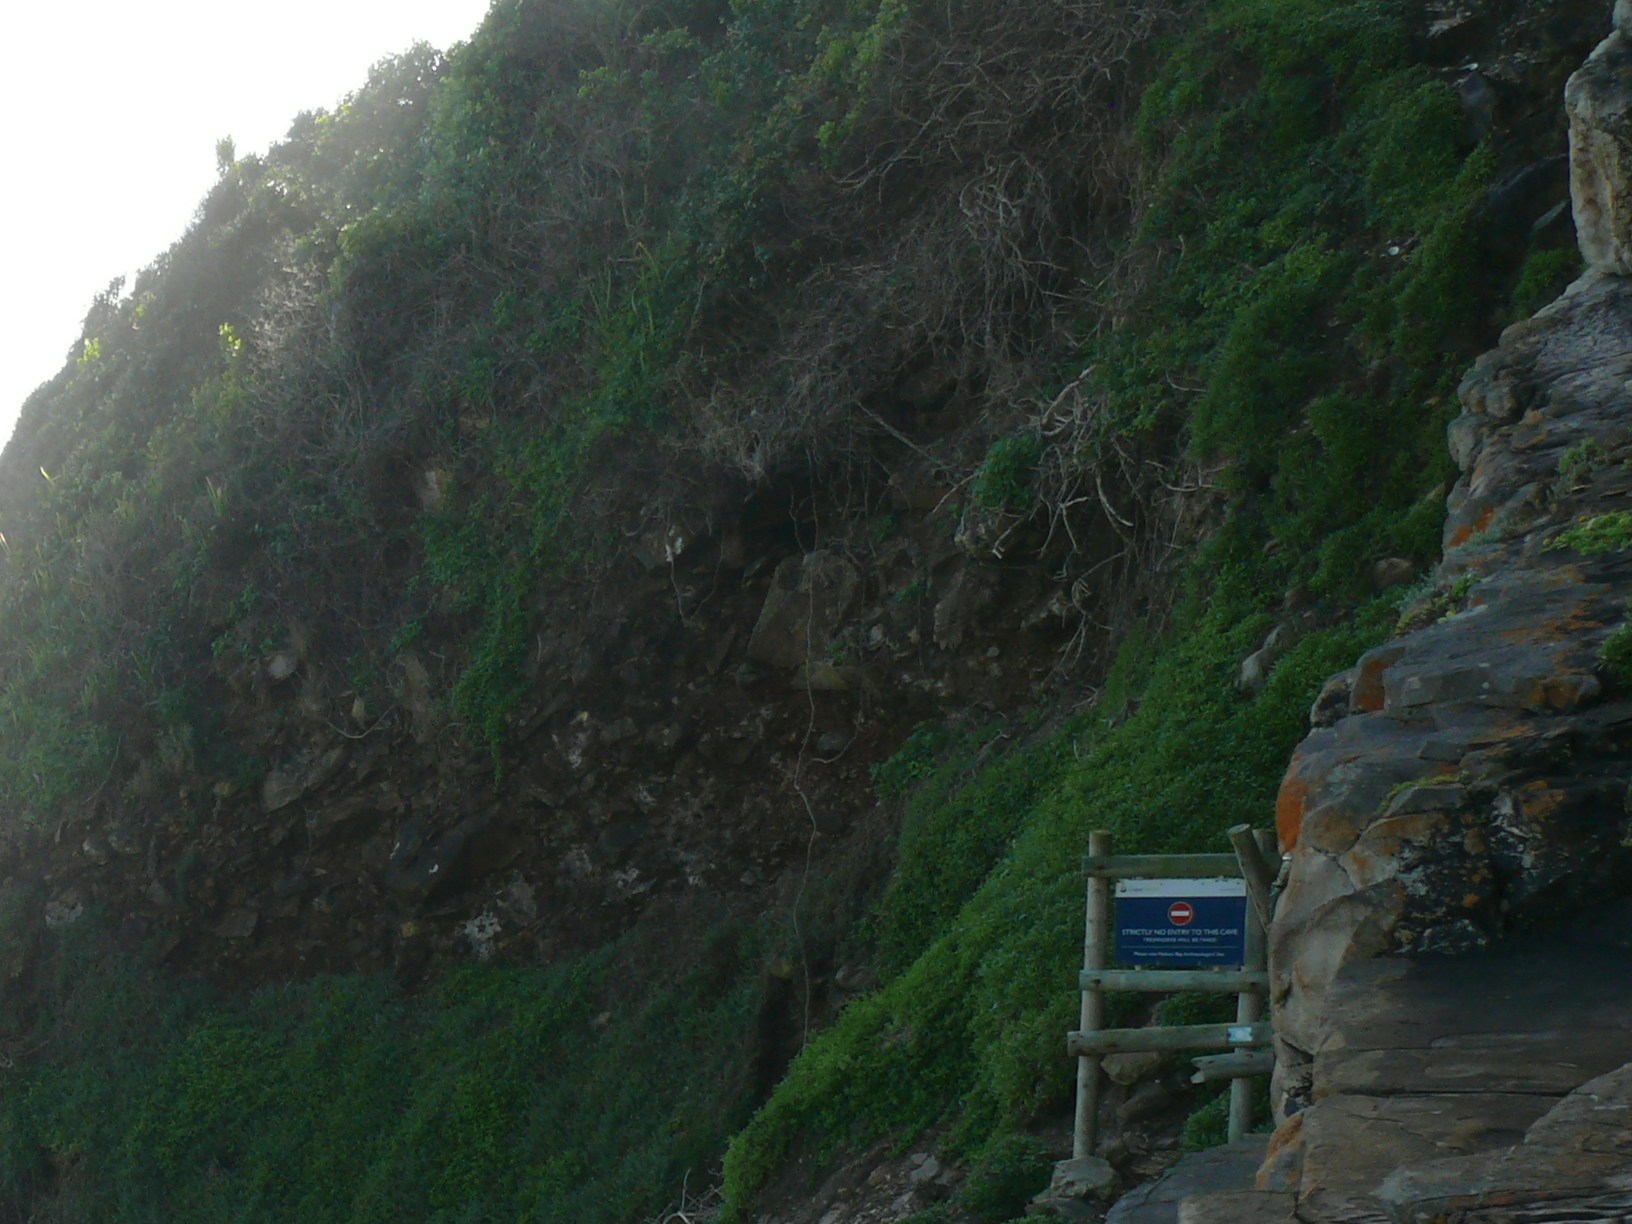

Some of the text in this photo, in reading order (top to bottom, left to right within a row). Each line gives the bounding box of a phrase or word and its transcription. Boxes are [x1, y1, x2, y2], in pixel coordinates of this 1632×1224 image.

[1121, 928, 1238, 936] STRICTLY NO ENTRY TO THIS CAVE
